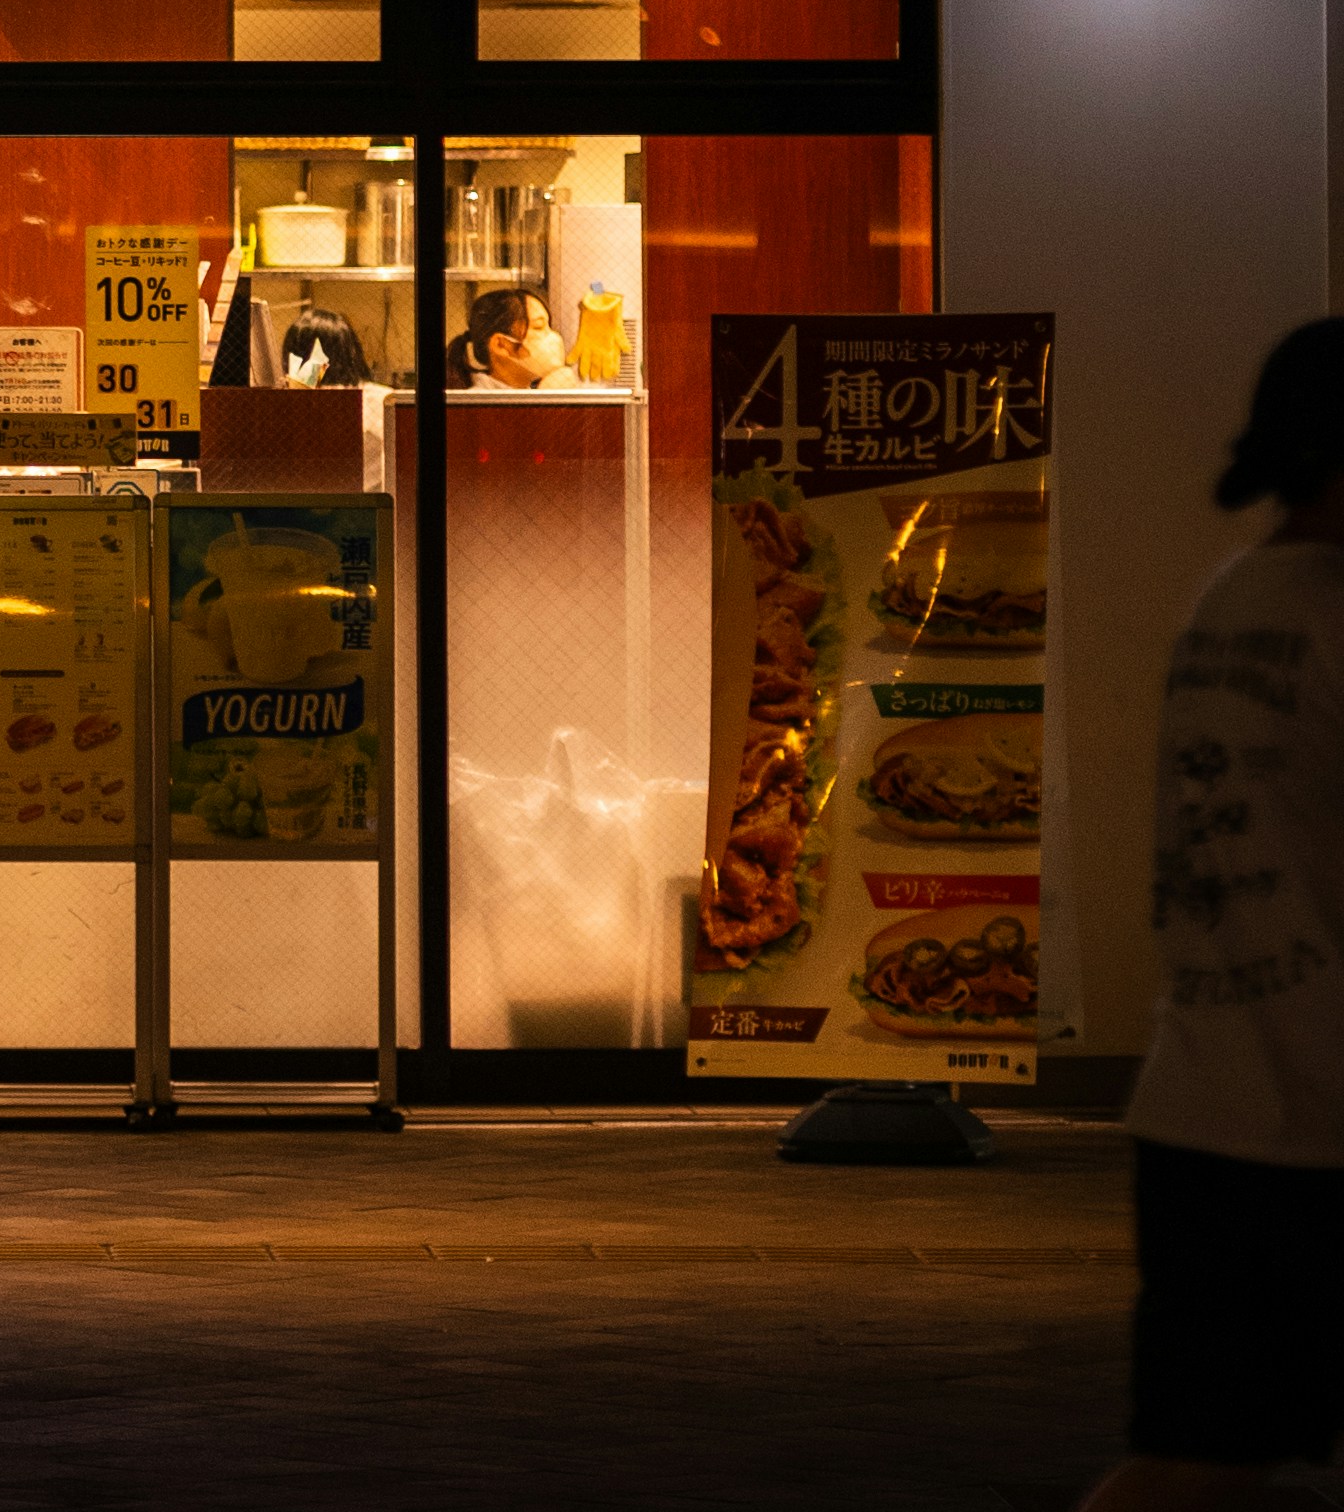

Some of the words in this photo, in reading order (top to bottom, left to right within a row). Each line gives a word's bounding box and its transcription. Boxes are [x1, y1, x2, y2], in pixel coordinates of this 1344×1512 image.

[147, 304, 189, 322] OFF
[825, 340, 1029, 363] 期間限定ミラノサンド
[98, 364, 137, 393] 30
[137, 399, 172, 428] 31
[825, 435, 941, 463] 牛カルビ
[203, 692, 347, 734] YOGURN
[710, 1010, 760, 1037] 定番
[763, 1019, 806, 1033] 牛カルビ
